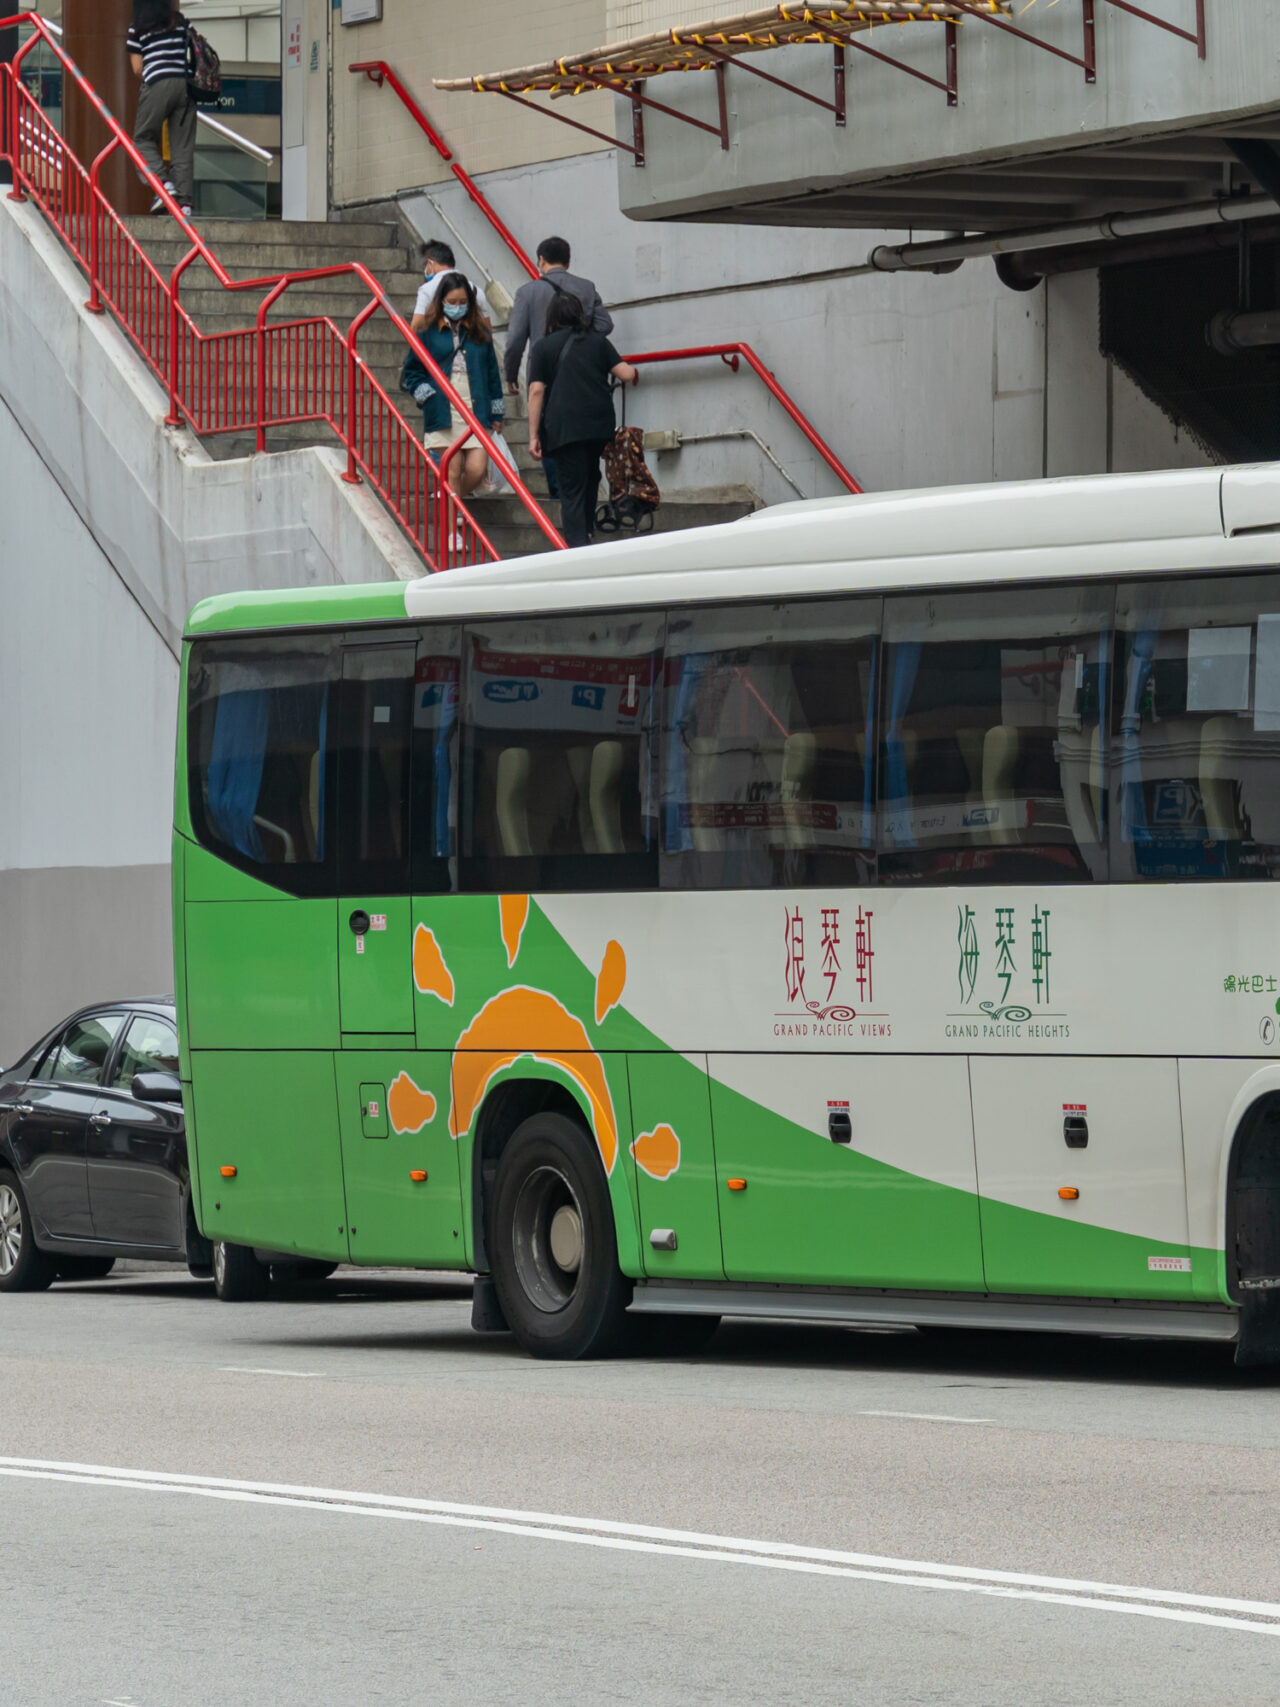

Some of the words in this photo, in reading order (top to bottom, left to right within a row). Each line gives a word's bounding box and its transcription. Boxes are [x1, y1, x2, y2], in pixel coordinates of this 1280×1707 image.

[1223, 974, 1277, 993] 陽光巴士
[774, 1024, 808, 1037] GRAND
[812, 1024, 854, 1037] PACIFIC
[860, 1024, 892, 1037] VIEWS
[945, 1024, 979, 1038] GRAND
[983, 1024, 1021, 1038] PACIFIC
[1028, 1024, 1070, 1038] HEIGHTS
